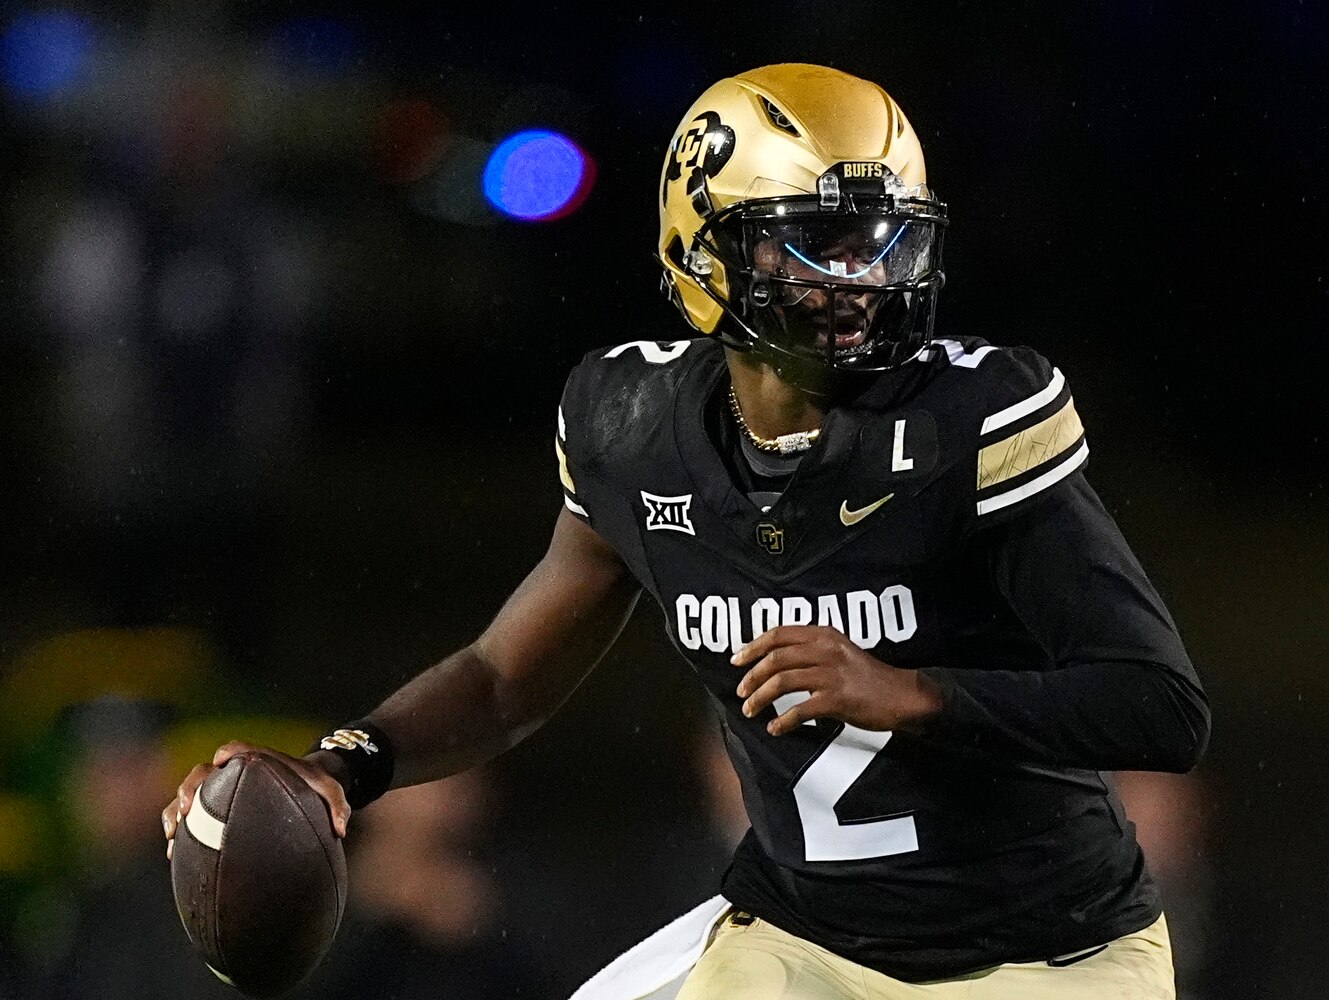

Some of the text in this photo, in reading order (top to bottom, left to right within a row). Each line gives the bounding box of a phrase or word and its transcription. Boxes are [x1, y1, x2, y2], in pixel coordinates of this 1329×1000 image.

[843, 163, 883, 178] BUFFS
[892, 419, 914, 472] L
[644, 496, 691, 532] XII
[676, 585, 918, 654] COLORADO
[772, 690, 919, 861] 2
